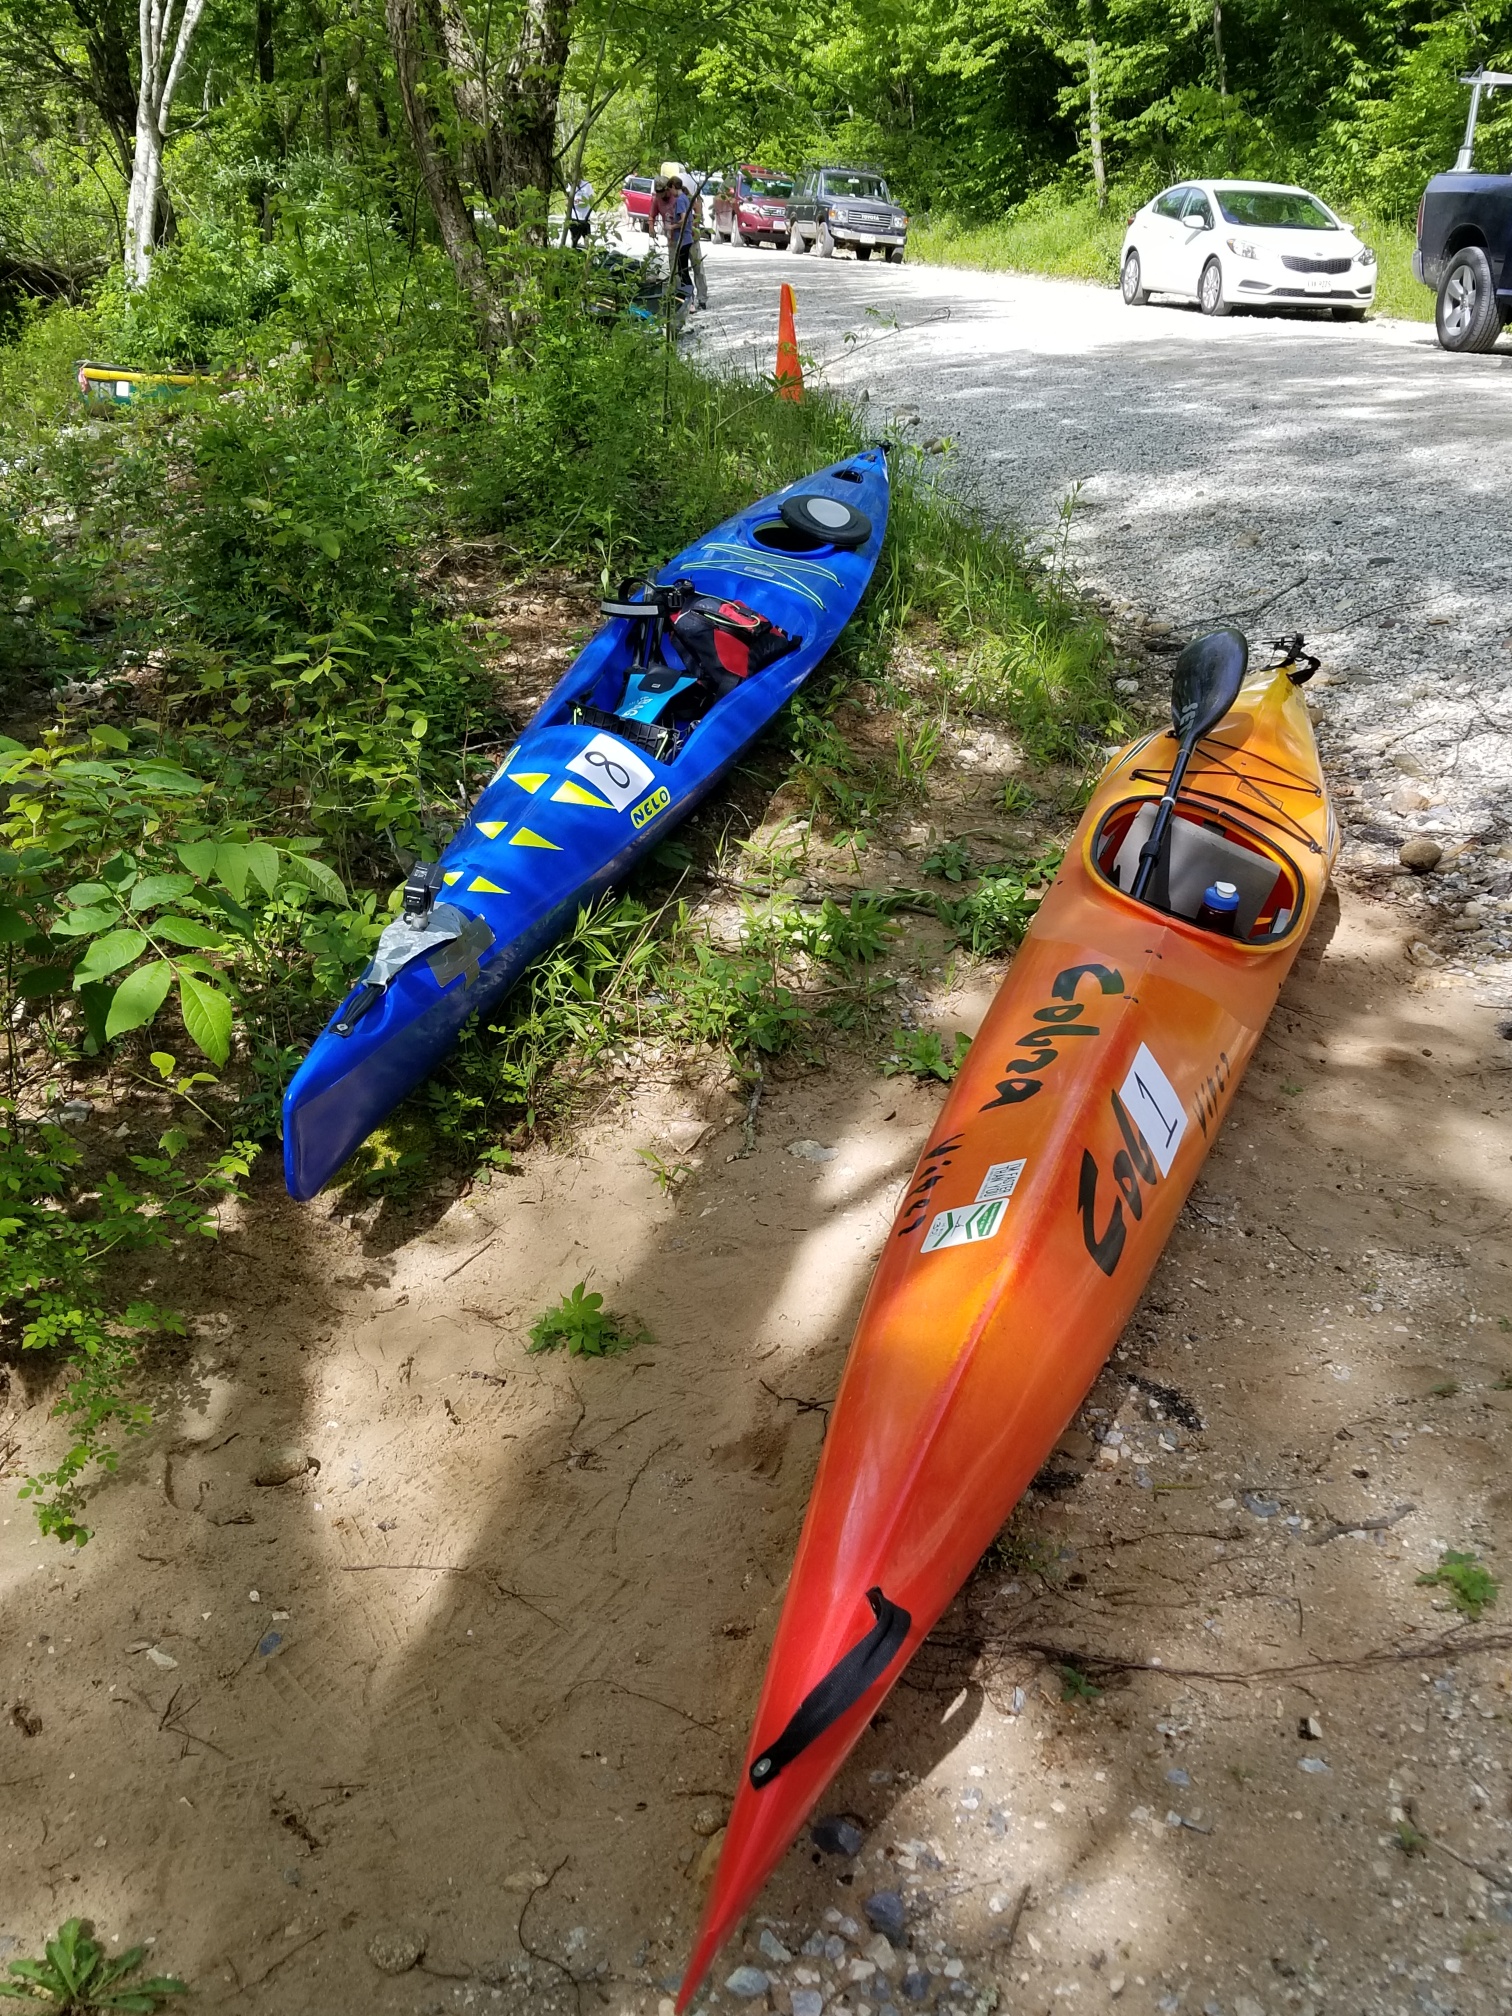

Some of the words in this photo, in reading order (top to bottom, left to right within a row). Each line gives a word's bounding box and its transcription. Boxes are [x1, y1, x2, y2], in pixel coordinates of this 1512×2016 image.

[584, 751, 630, 789] 8
[633, 789, 669, 827] NELO
[977, 963, 1125, 1112] Cobra
[1133, 1070, 1179, 1149] 1
[897, 1132, 966, 1238] Viper
[983, 1183, 1002, 1197] YOU
[991, 1165, 1009, 1183] THAN
[997, 1172, 1018, 1194] FASTER
[1077, 1088, 1157, 1277] Cob
